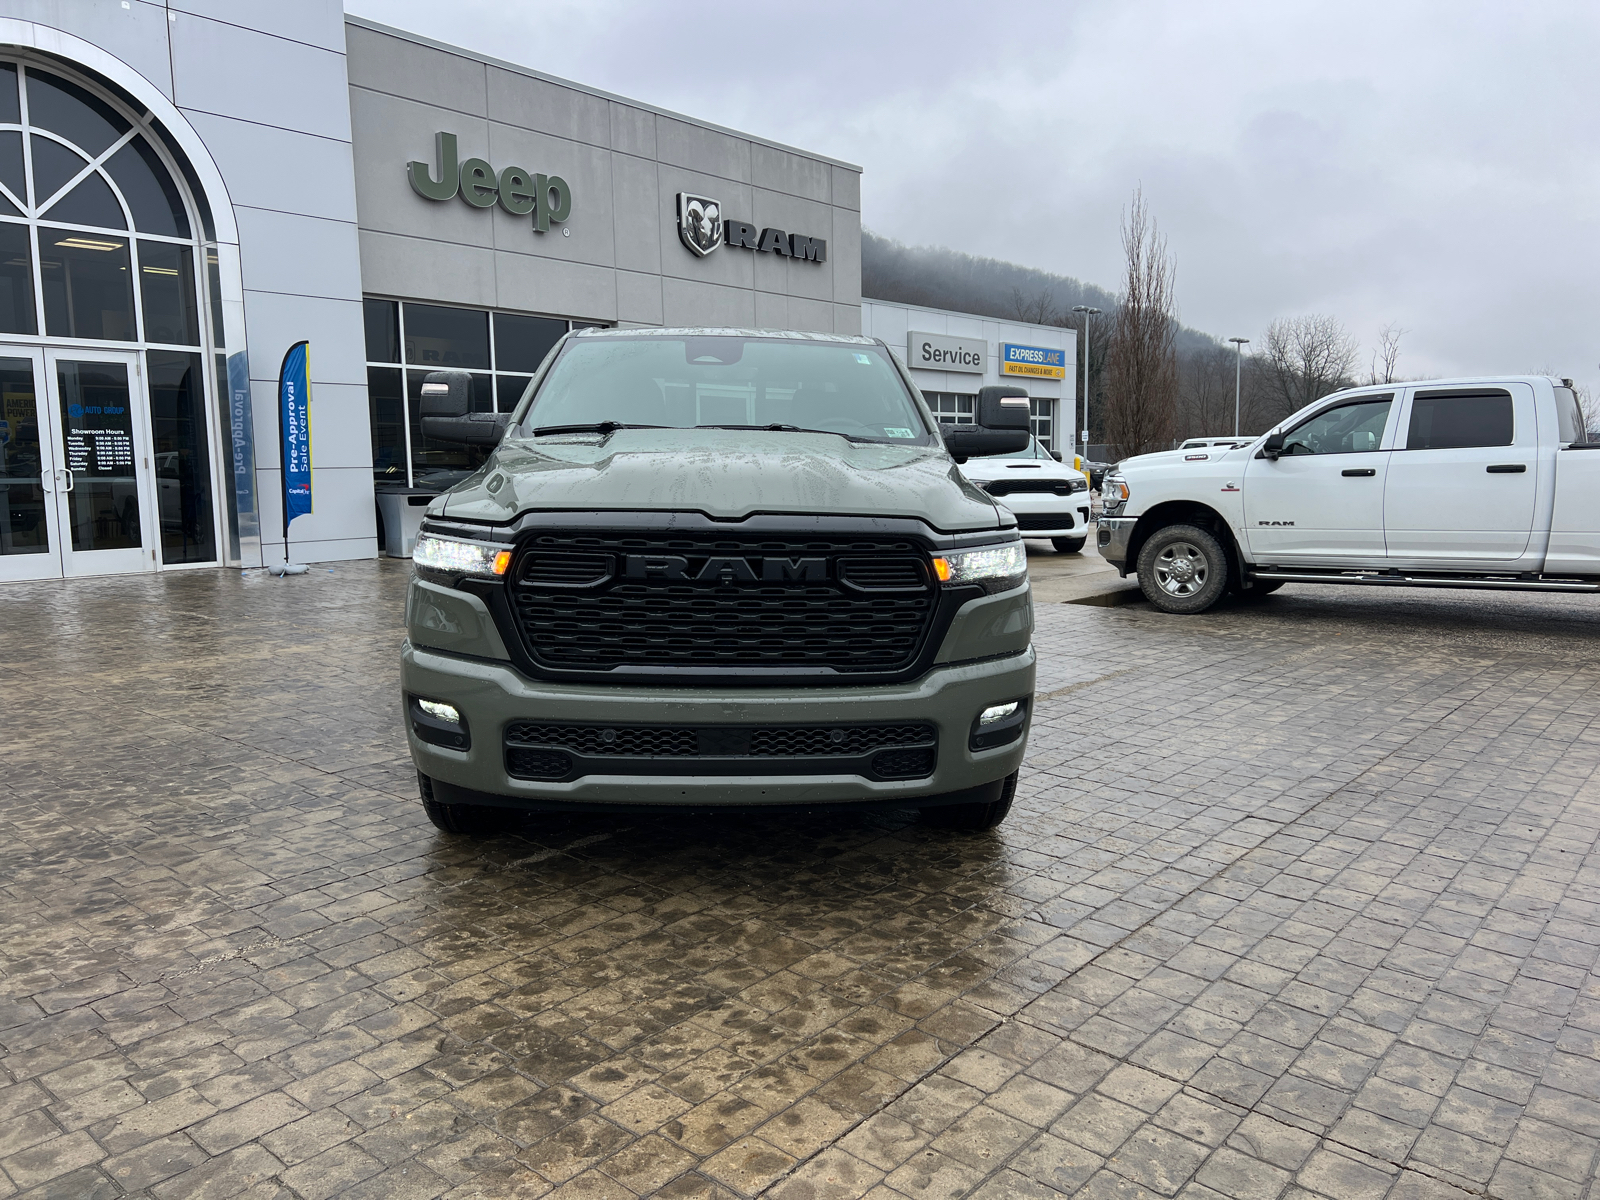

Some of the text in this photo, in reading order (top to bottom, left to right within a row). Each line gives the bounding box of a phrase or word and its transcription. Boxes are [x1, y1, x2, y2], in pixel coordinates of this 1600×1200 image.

[407, 131, 572, 232] Jeep
[724, 219, 827, 262] RAM
[422, 349, 484, 364] RAM
[922, 342, 980, 366] Service
[85, 406, 101, 414] AUTO
[104, 406, 124, 414] GROUP
[287, 382, 298, 473] Pre-Approval
[298, 405, 308, 472] Sale Event
[626, 554, 826, 582] RAM
